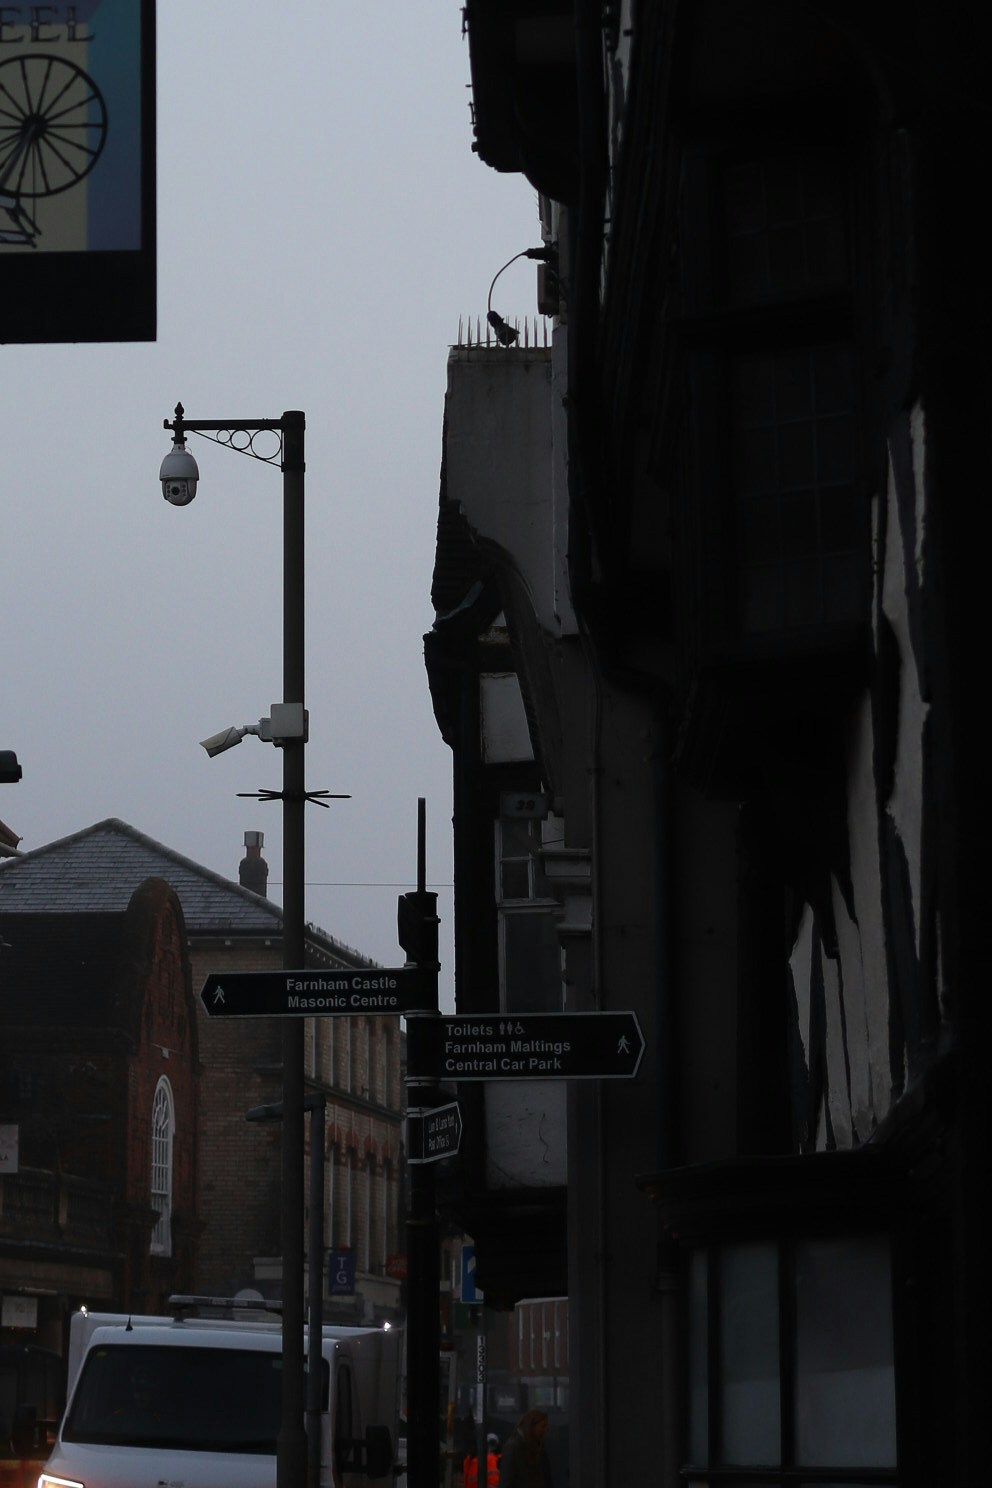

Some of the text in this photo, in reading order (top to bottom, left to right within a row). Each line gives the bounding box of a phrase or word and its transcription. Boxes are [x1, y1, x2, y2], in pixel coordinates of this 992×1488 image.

[286, 977, 397, 991] Farnham Castle
[287, 994, 398, 1008] Masonic Centre
[445, 1023, 494, 1036] Toilets
[444, 1039, 571, 1054] Farnham Maltings
[445, 1057, 562, 1071] Central Car Park
